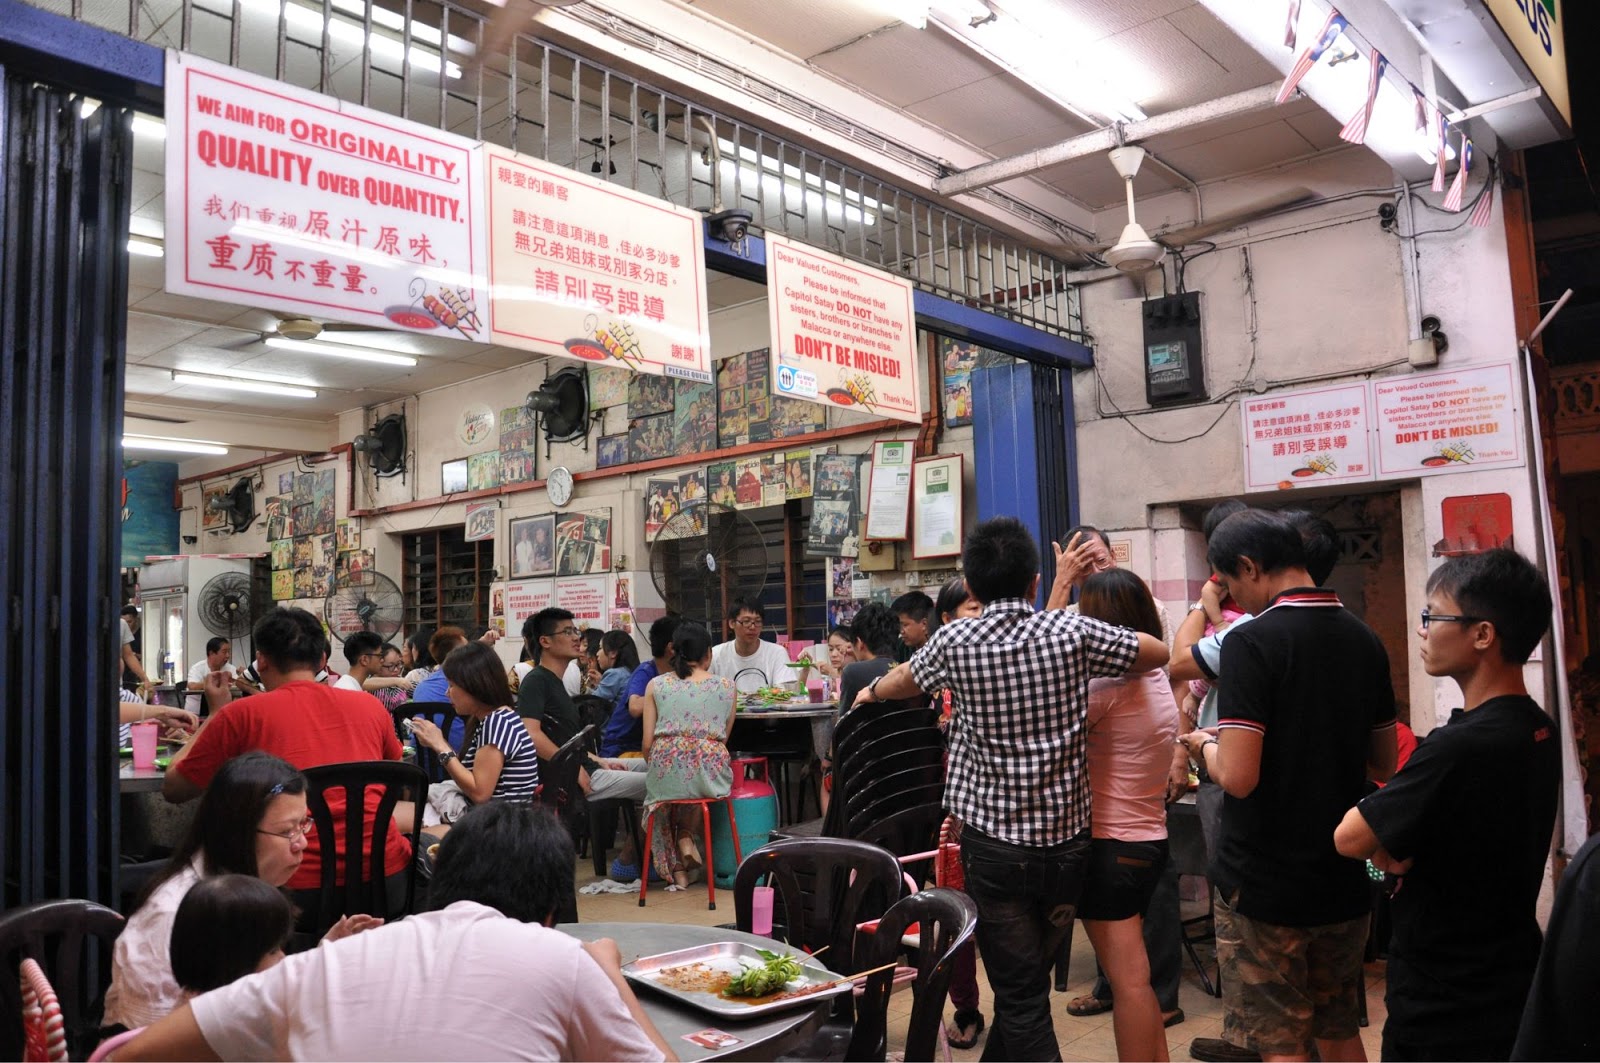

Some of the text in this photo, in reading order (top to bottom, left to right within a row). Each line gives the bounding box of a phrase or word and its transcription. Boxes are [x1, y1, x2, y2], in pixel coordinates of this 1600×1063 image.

[197, 95, 460, 184] WE AIM FOR ORIGINALITY,
[197, 130, 464, 224] QUALITY OVER QUANTITY.
[498, 166, 569, 201] 親愛的顧客
[777, 251, 794, 264] Dear
[796, 257, 820, 272] Valued
[534, 268, 665, 322] 請別受誤導
[803, 276, 886, 310] Please be informed that
[785, 286, 903, 331] Capitol Satay DO NOT have any
[790, 303, 900, 341] sisters, brothers or branches in
[801, 319, 831, 336] Malacca
[833, 329, 841, 338] or
[842, 332, 876, 349] anywhere
[671, 343, 694, 362] 謝謝
[794, 334, 832, 363] DON'T
[836, 344, 850, 367] BE
[853, 348, 901, 379] MISLED!
[668, 366, 711, 382] PLEASE QUEUE
[1378, 387, 1393, 395] Dear
[1395, 383, 1417, 392] Valued
[1400, 394, 1424, 403] Please
[1436, 388, 1470, 398] informed
[883, 392, 913, 408] Thank You
[1383, 406, 1408, 415] Capitol
[1432, 400, 1446, 409] DO
[1449, 397, 1470, 406] NOT
[1398, 421, 1427, 430] Malacca
[1438, 415, 1474, 425] anywhere
[1416, 411, 1447, 419] brothers
[1458, 405, 1493, 414] branches
[1395, 422, 1499, 445] DON'T BE MISLED!
[1272, 435, 1348, 456] 請別受誤導
[1478, 451, 1499, 459] Thank
